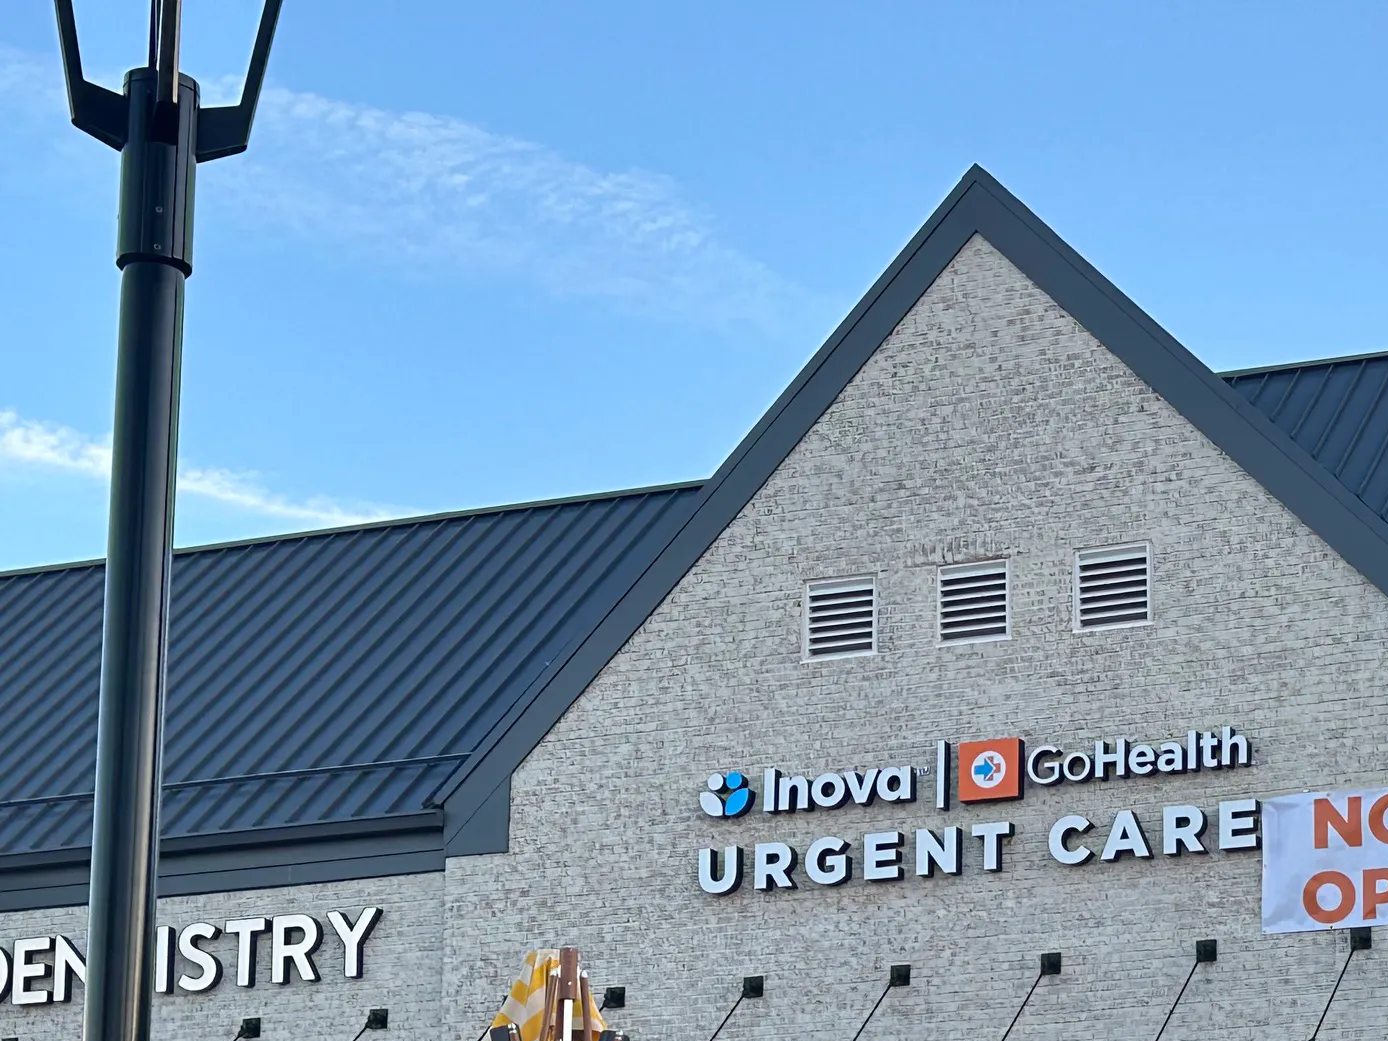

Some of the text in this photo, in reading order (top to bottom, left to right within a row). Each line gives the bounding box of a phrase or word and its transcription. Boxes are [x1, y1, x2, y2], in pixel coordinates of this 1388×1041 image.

[763, 765, 912, 812] Inova
[1027, 726, 1250, 785] GoHealth
[698, 799, 1259, 895] URGENT CARE
[0, 907, 380, 1005] ENISTRY
